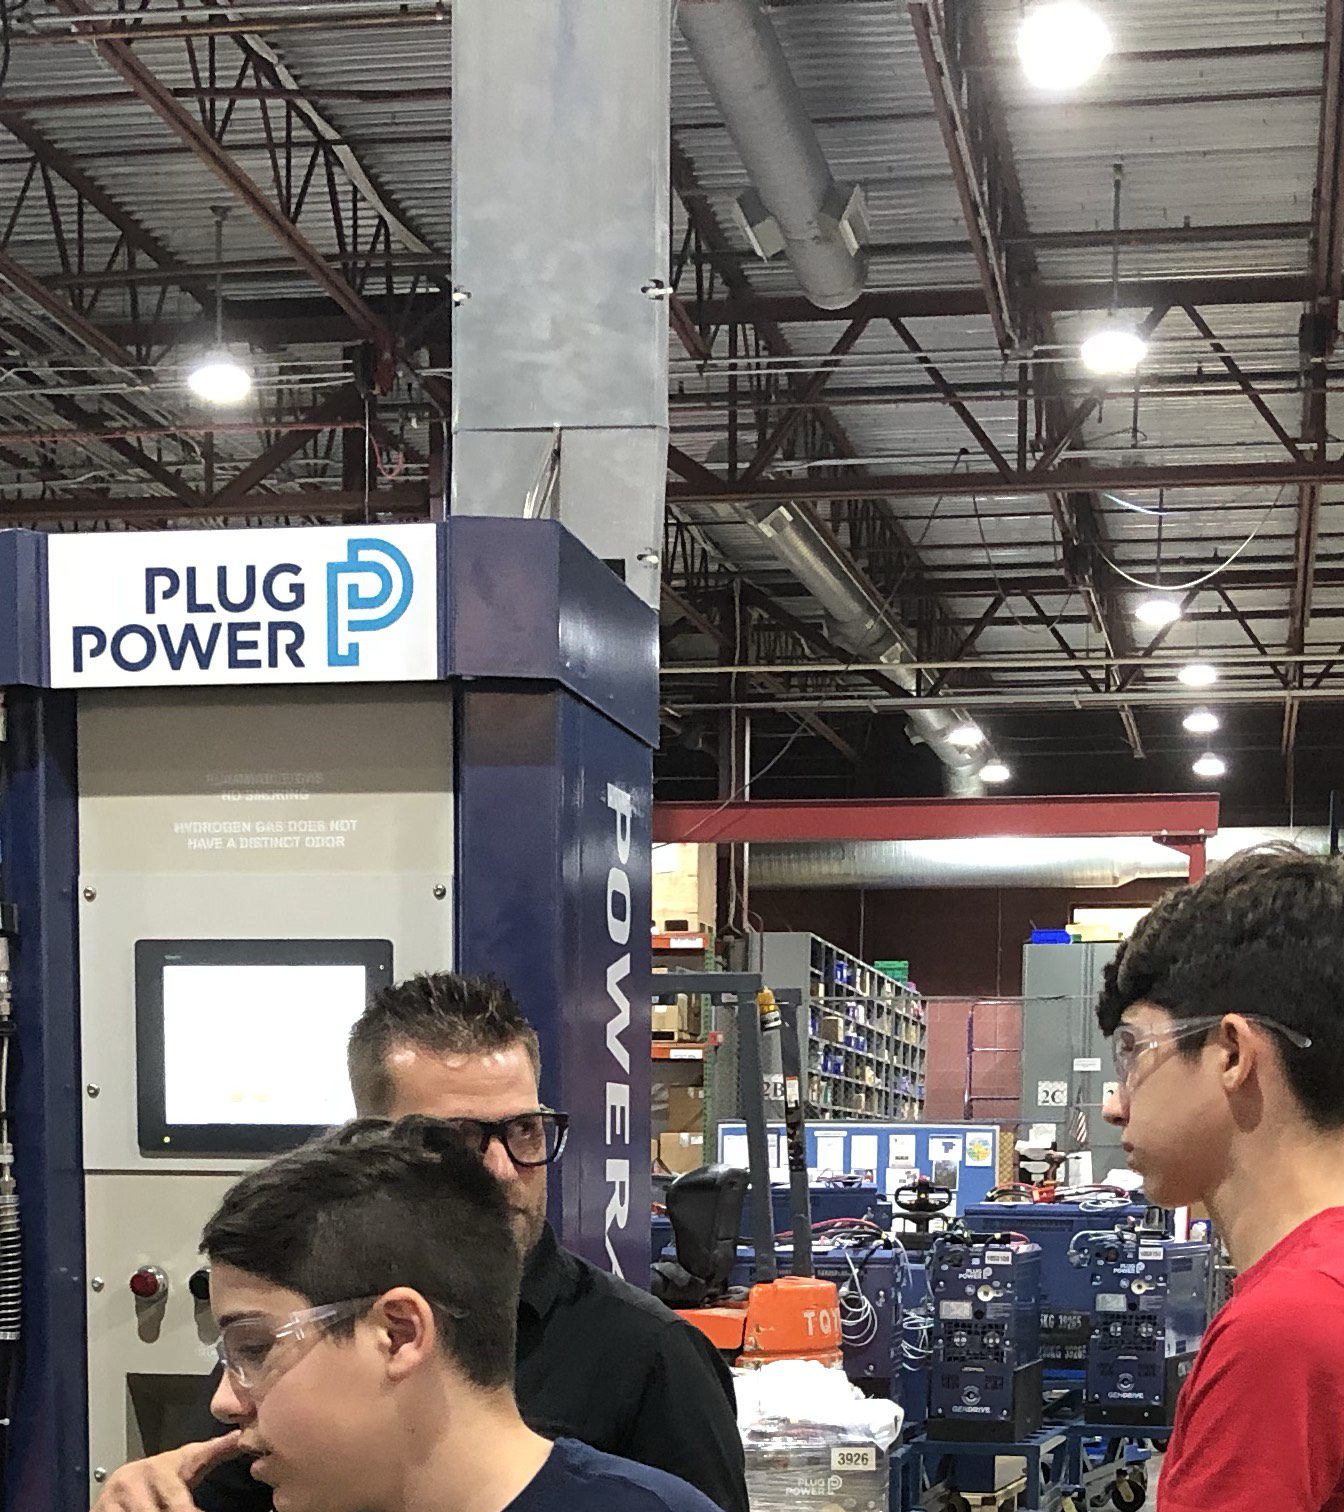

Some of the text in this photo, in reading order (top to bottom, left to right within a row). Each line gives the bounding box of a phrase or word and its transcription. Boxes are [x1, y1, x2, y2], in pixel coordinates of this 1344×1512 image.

[145, 562, 306, 615] PLUG
[72, 620, 306, 673] POWER
[174, 819, 358, 834] HYDROGEN GAS DOES NOT
[187, 835, 346, 850] HAVE A DISTINCT ODOR
[1041, 1089, 1065, 1105] 2C
[837, 1452, 869, 1466] 3926
[785, 1487, 826, 1496] POWER
